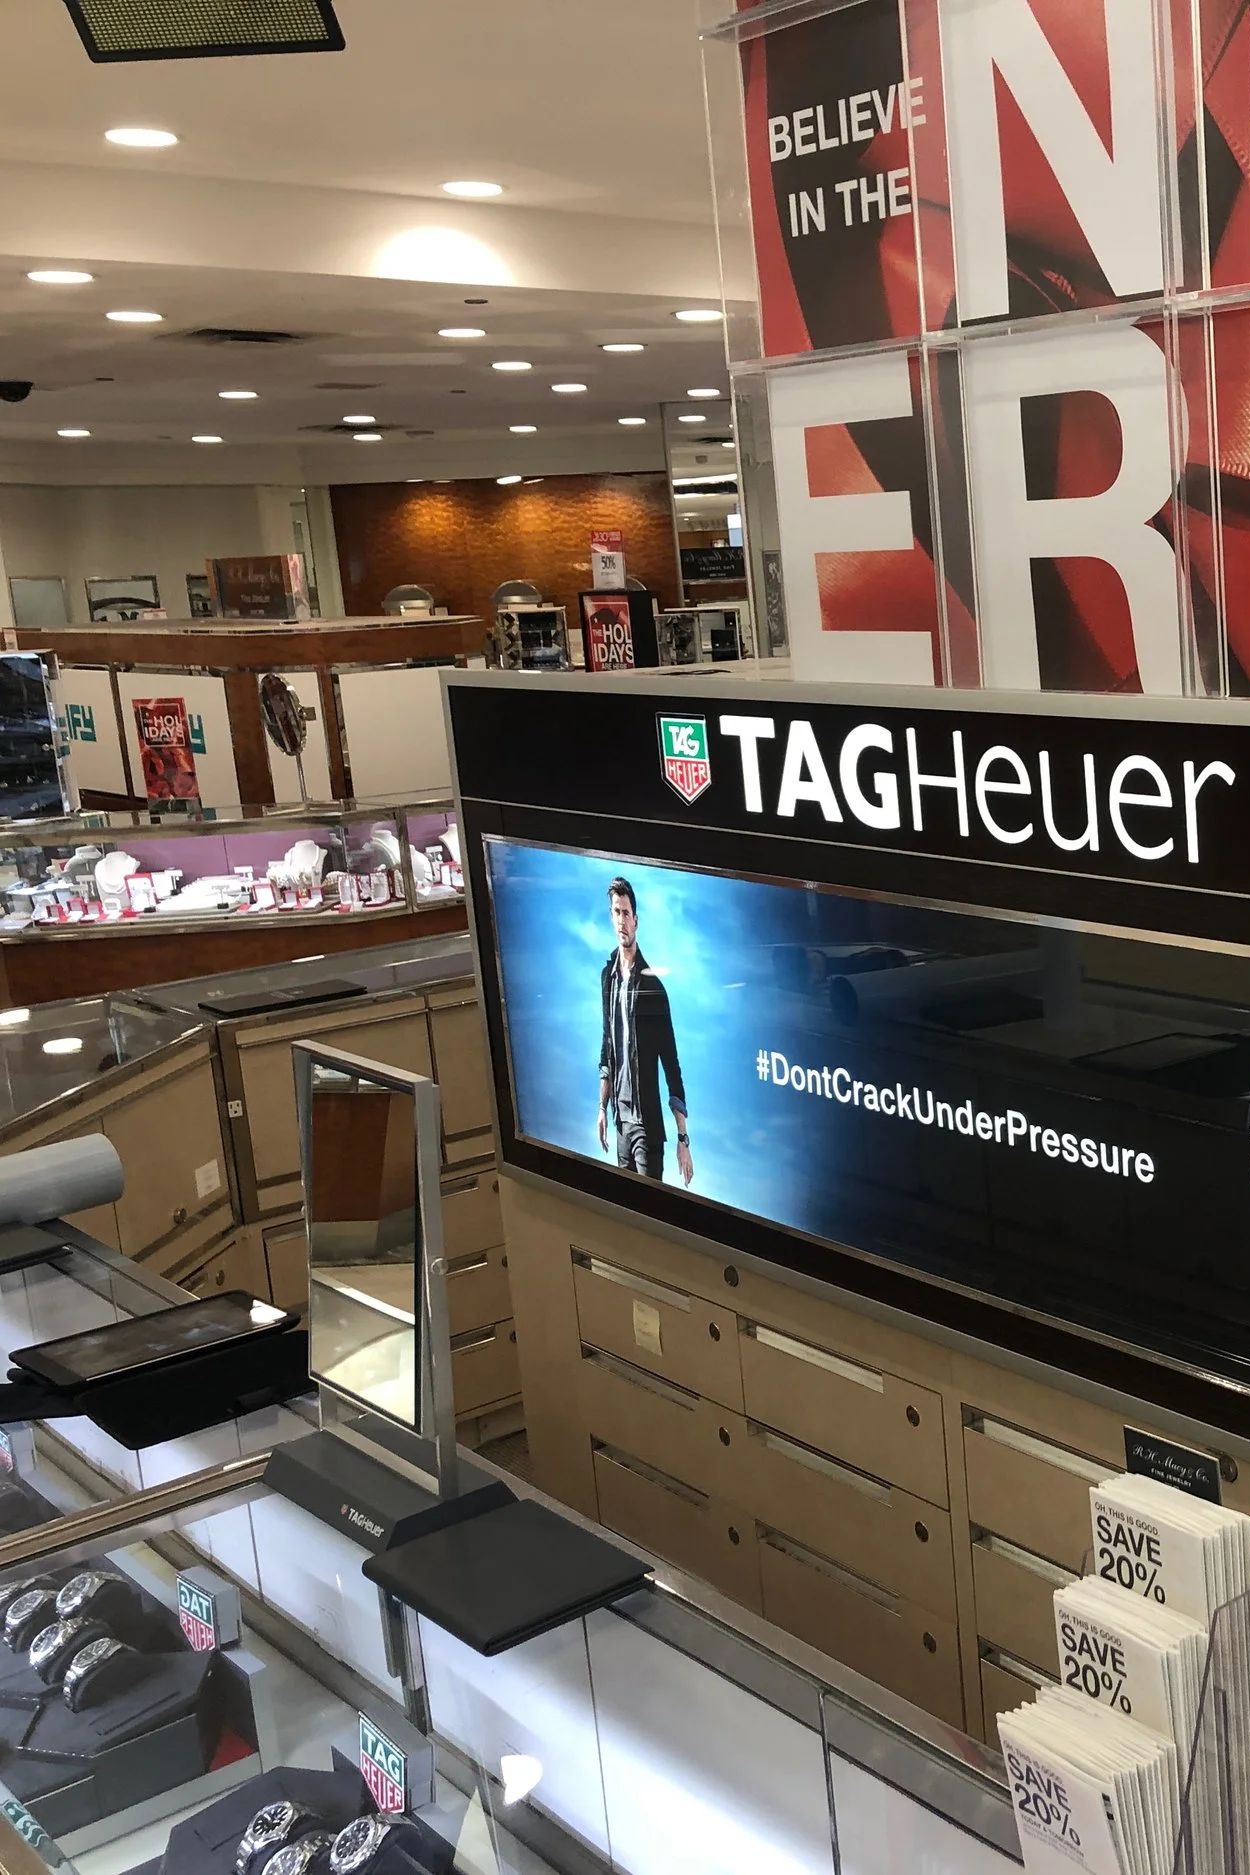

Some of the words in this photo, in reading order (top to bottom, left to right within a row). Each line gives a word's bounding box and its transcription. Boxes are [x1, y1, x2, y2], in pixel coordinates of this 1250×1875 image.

[768, 77, 927, 162] BELIEVE
[788, 187, 826, 238] IN
[835, 167, 912, 227] THE
[601, 555, 616, 570] 50%
[593, 629, 603, 637] THE
[603, 624, 633, 643] HOL
[594, 643, 634, 663] IDAYS
[145, 726, 184, 738] IDAYS
[153, 714, 182, 726] HOL
[668, 725, 700, 757] TAG
[668, 760, 707, 795] HEUER
[756, 1049, 1156, 1184] #DontCrackUnderPressure
[1095, 1501, 1108, 1516] OH,
[1108, 1508, 1125, 1522] THIS
[1126, 1516, 1134, 1526] IS
[1097, 1514, 1163, 1567] SAVE
[1099, 1546, 1166, 1605] 20%
[1061, 1622, 1128, 1678] SAVE
[1072, 1616, 1089, 1631] THIS
[1090, 1625, 1098, 1635] IS
[1064, 1655, 1132, 1714] 20%
[363, 1727, 400, 1783] TAG
[362, 1756, 402, 1810] HEUER
[1007, 1752, 1072, 1813] SAVE
[1014, 1782, 1081, 1847] 20%
